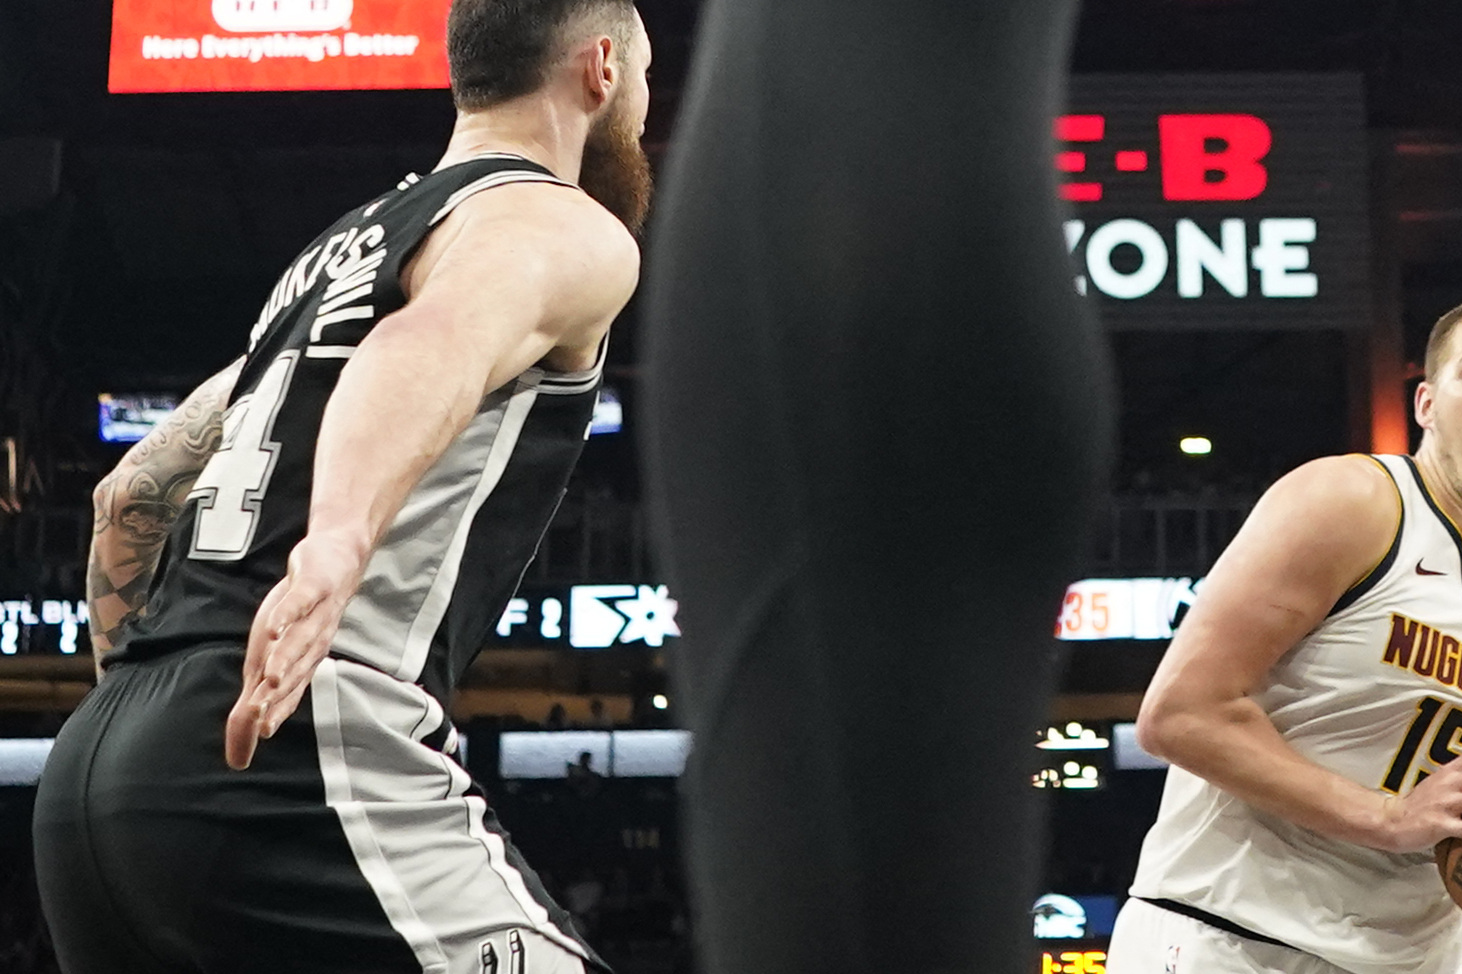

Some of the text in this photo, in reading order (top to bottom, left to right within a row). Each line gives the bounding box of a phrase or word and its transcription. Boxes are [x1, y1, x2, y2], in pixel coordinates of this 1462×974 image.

[142, 32, 419, 62] Here Everything's Better
